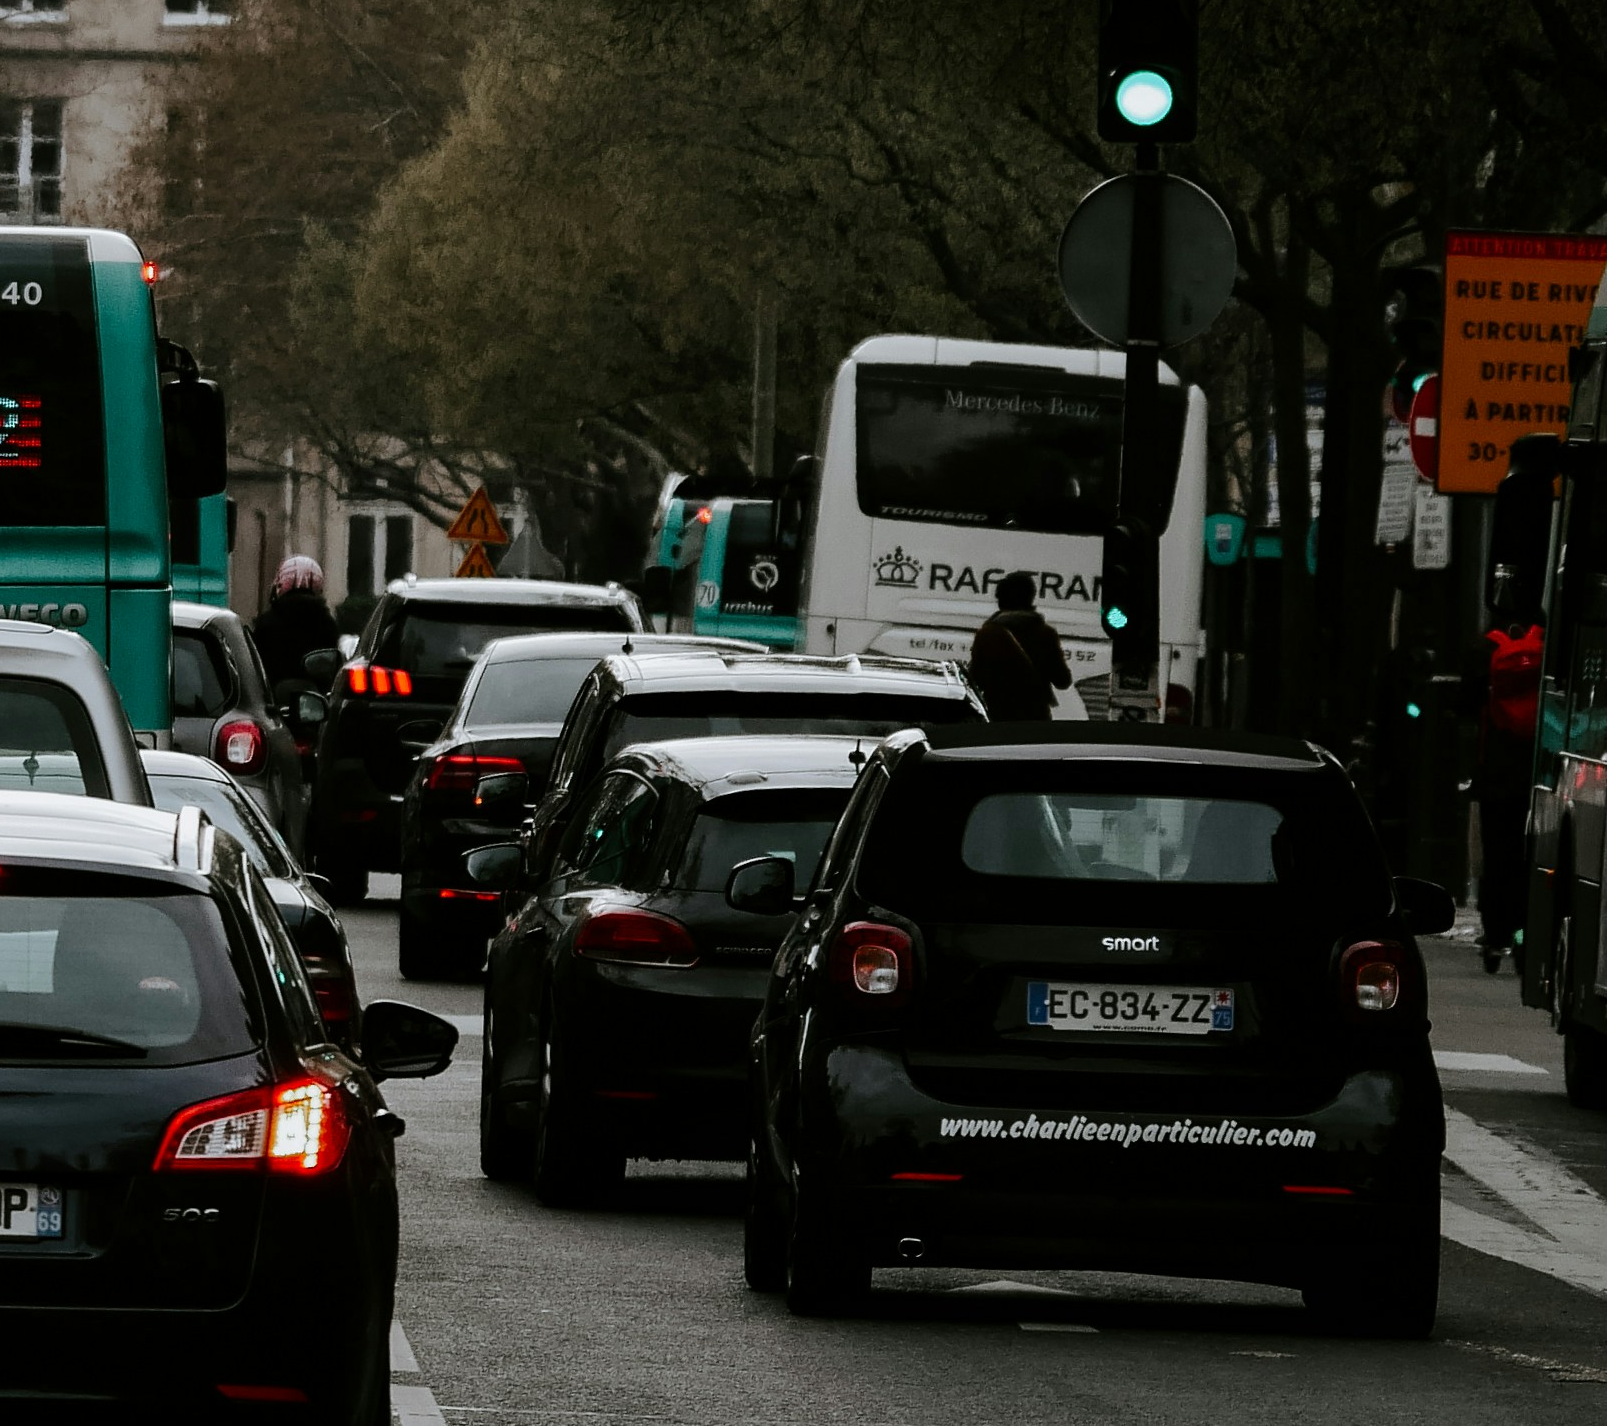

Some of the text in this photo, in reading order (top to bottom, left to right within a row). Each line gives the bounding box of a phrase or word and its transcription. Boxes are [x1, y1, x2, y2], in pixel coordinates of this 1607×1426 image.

[1452, 238, 1546, 256] ATTENTION
[1456, 280, 1503, 301] RUE
[1511, 281, 1540, 301] DE
[1465, 398, 1570, 423] À PARTIR
[1468, 441, 1507, 462] 30-
[880, 505, 990, 521] TOURISMO
[698, 584, 716, 605] 70
[1102, 936, 1160, 952] smart
[1049, 990, 1211, 1023] EC-834-ZZ
[1215, 1011, 1231, 1026] 75
[940, 1113, 1317, 1149] www.charlieenparticulier.com
[37, 1211, 62, 1232] 69
